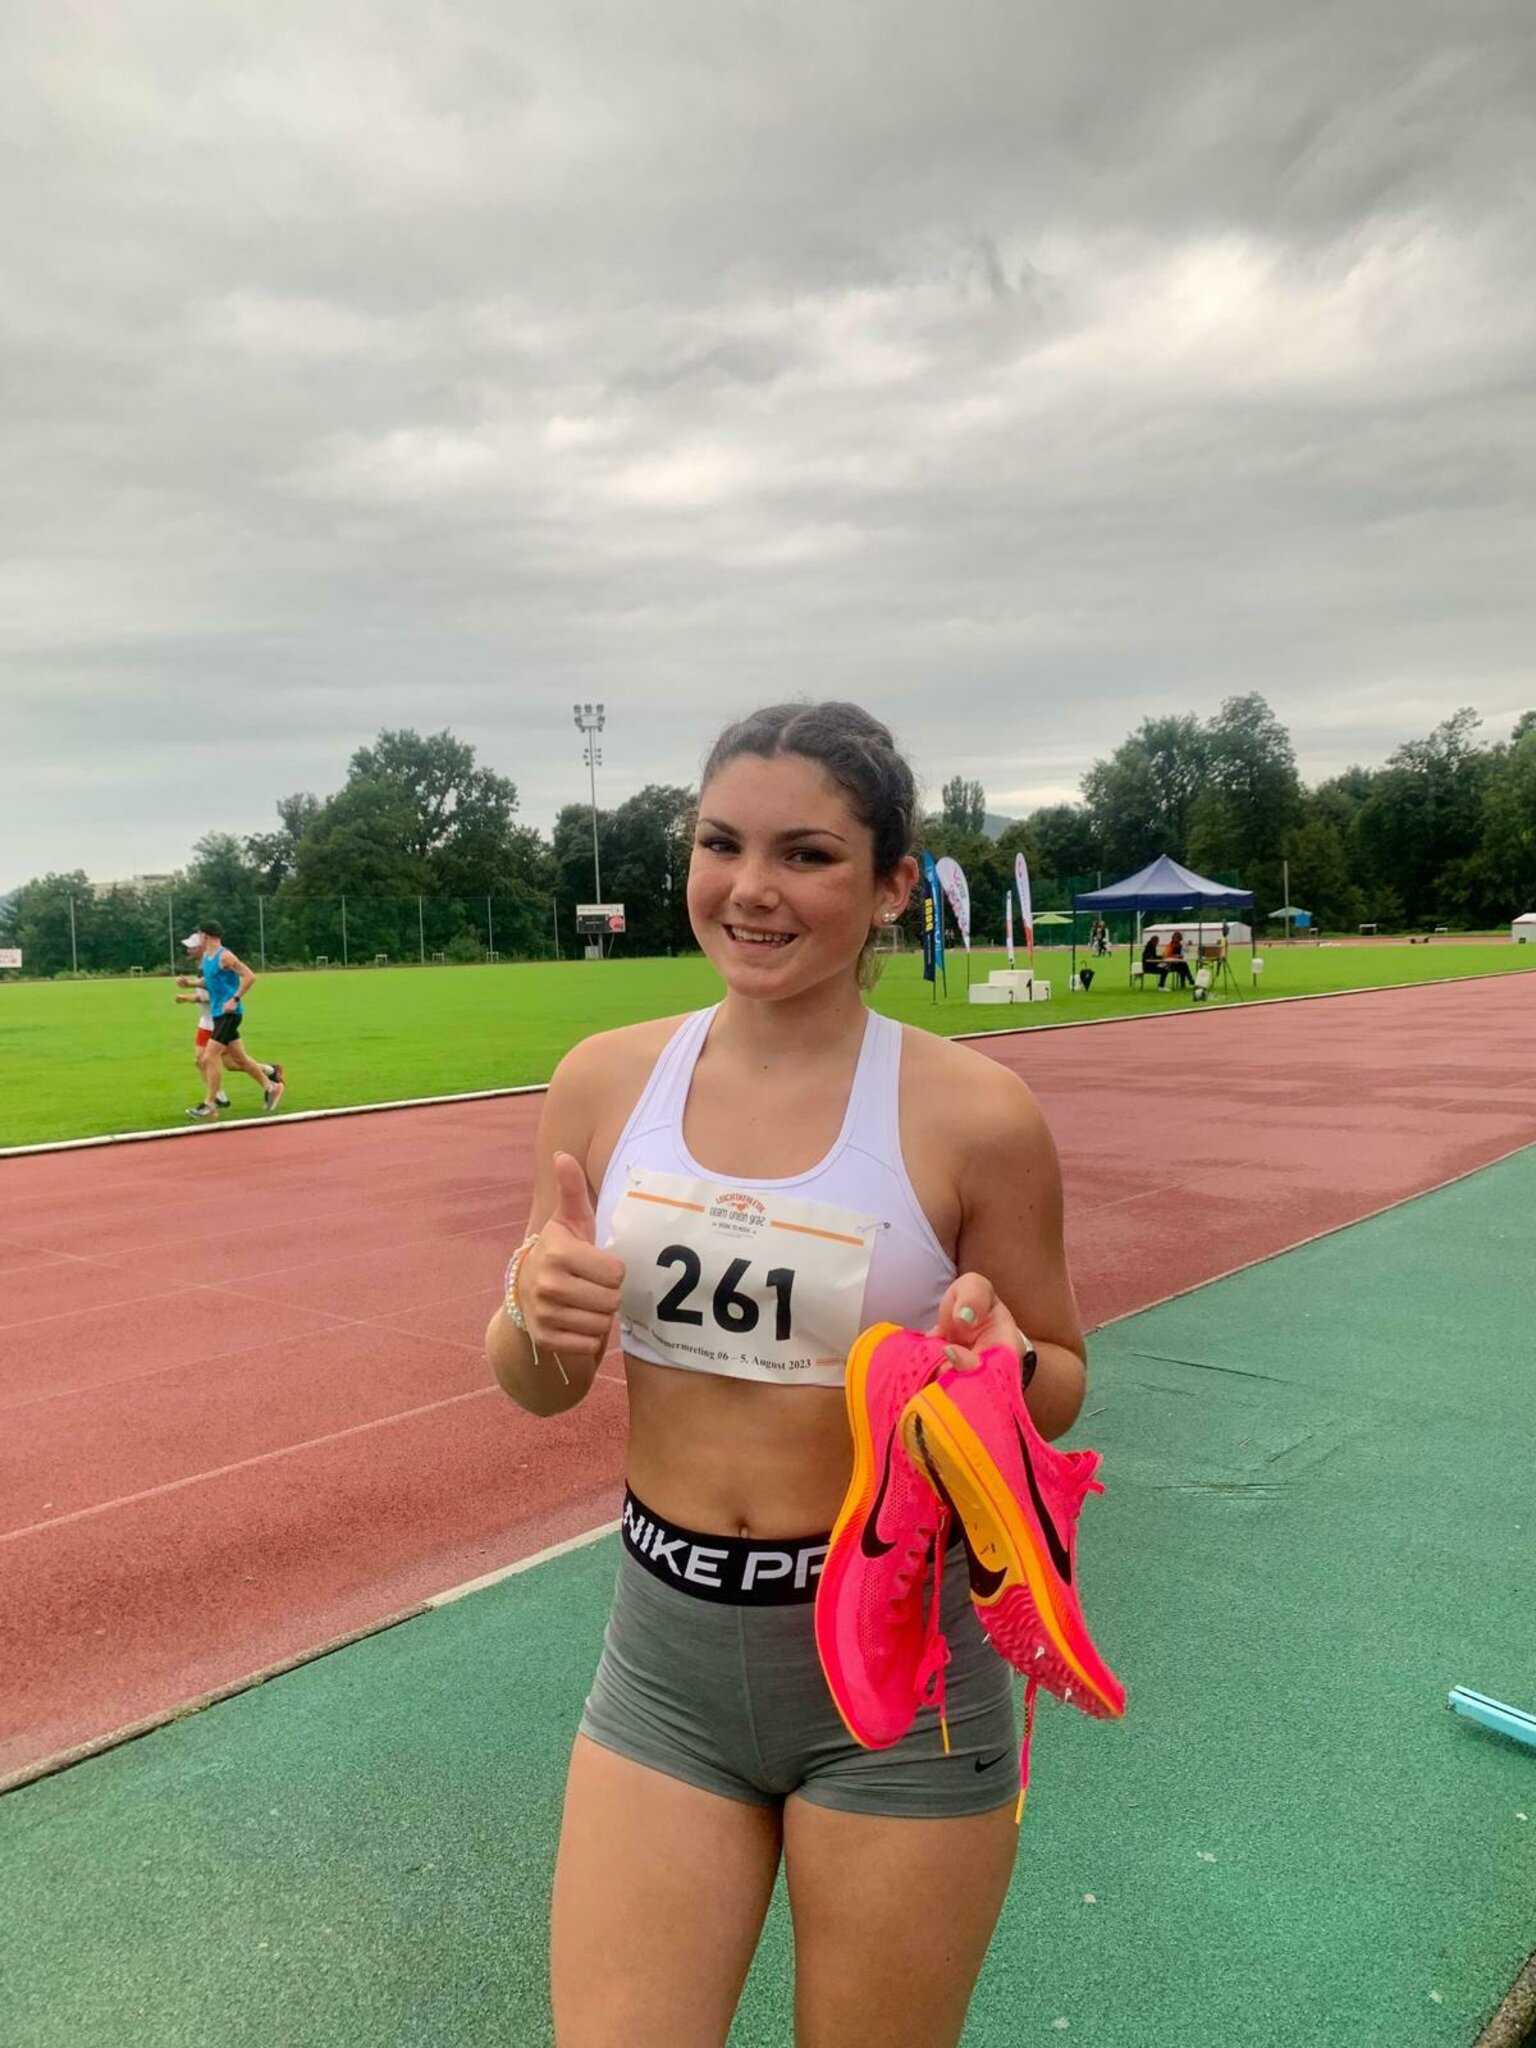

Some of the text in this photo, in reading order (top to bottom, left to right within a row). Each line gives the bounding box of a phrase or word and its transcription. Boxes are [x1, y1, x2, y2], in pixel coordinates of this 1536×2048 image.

[1026, 978, 1032, 1001] 1
[656, 1244, 795, 1341] 261
[752, 1355, 786, 1370] August
[788, 1358, 811, 1370] 2023
[624, 1501, 831, 1591] NIKE PR
